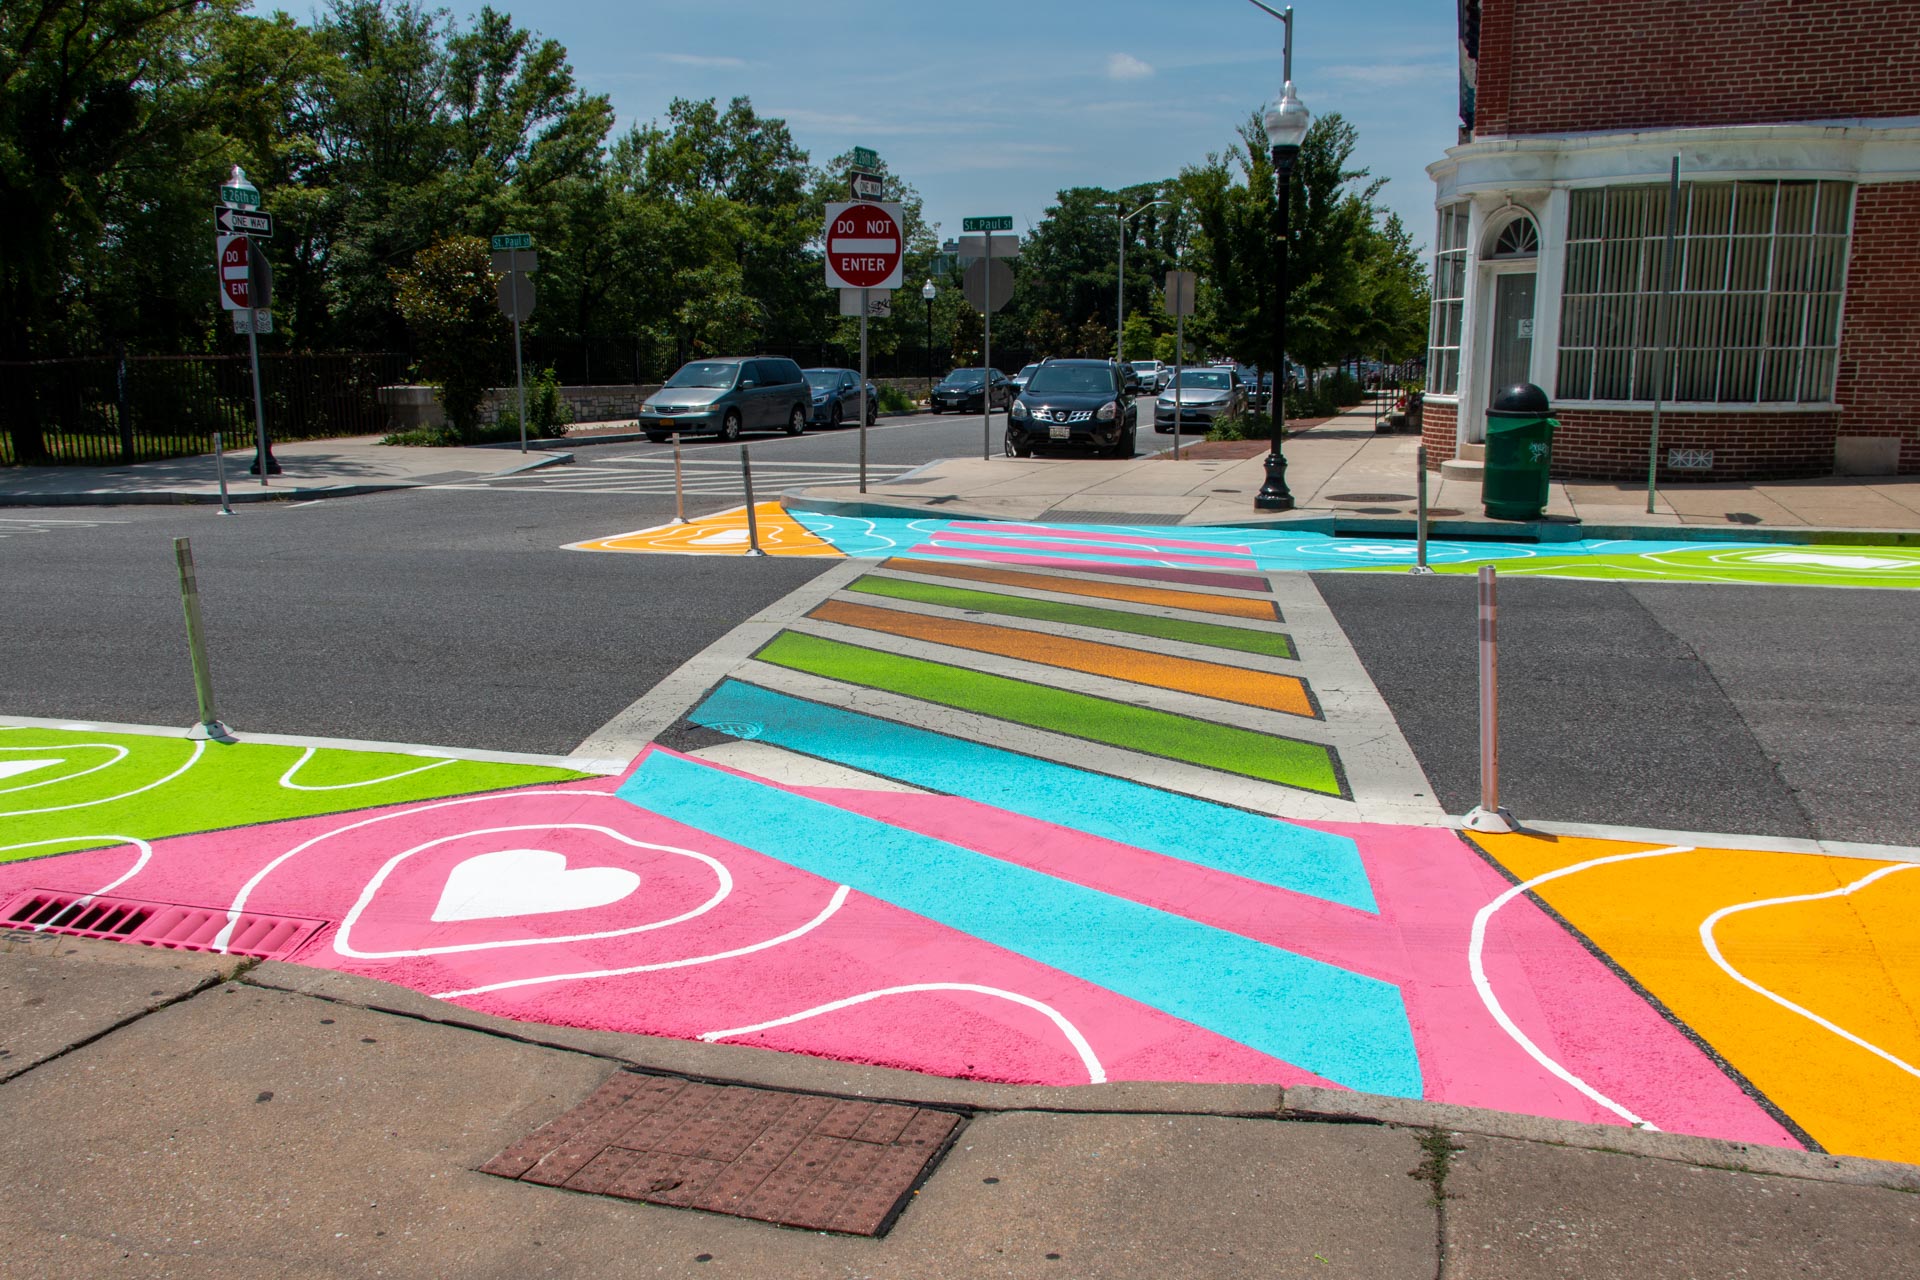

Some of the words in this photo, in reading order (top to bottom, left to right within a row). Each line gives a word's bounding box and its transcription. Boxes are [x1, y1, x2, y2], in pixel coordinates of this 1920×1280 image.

[860, 181, 869, 193] ONE
[870, 183, 880, 194] WAY
[223, 190, 228, 200] E
[229, 189, 249, 203] 26th
[232, 215, 249, 227] ONE
[251, 218, 266, 229] WAY
[837, 220, 855, 234] DO
[866, 220, 891, 234] NOT
[964, 219, 977, 231] St.
[979, 218, 1001, 230] Paul
[505, 236, 522, 246] Paul
[226, 250, 239, 262] DO
[842, 257, 885, 271] ENTER
[232, 283, 248, 295] ENT
